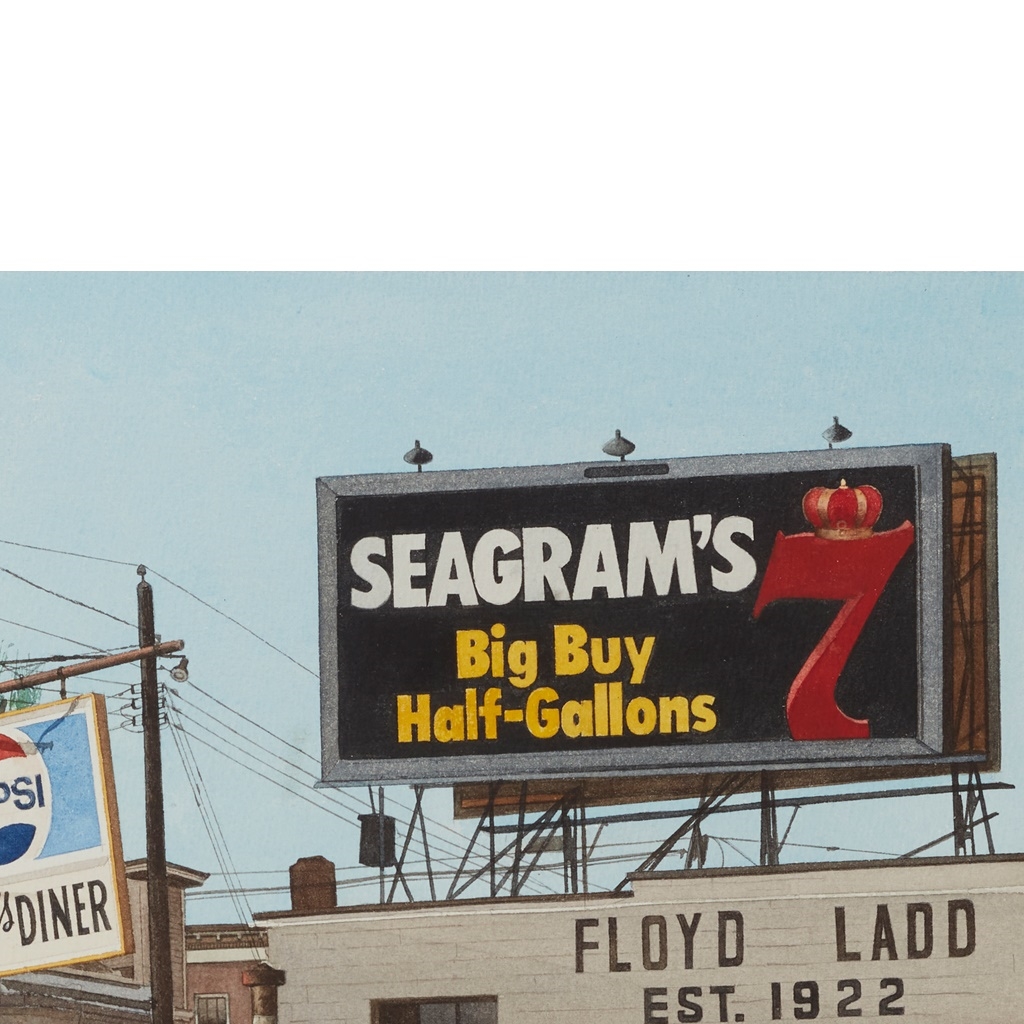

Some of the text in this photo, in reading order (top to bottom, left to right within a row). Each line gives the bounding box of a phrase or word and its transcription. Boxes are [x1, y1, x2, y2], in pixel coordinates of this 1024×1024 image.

[349, 513, 758, 610] SEAGRAM'S
[455, 622, 656, 689] Big Buy
[752, 519, 915, 742] 7
[396, 683, 717, 744] Half-Gallons
[14, 879, 112, 946] DINER
[575, 898, 976, 974] FLOYD LADD
[771, 977, 905, 1021] 1922
